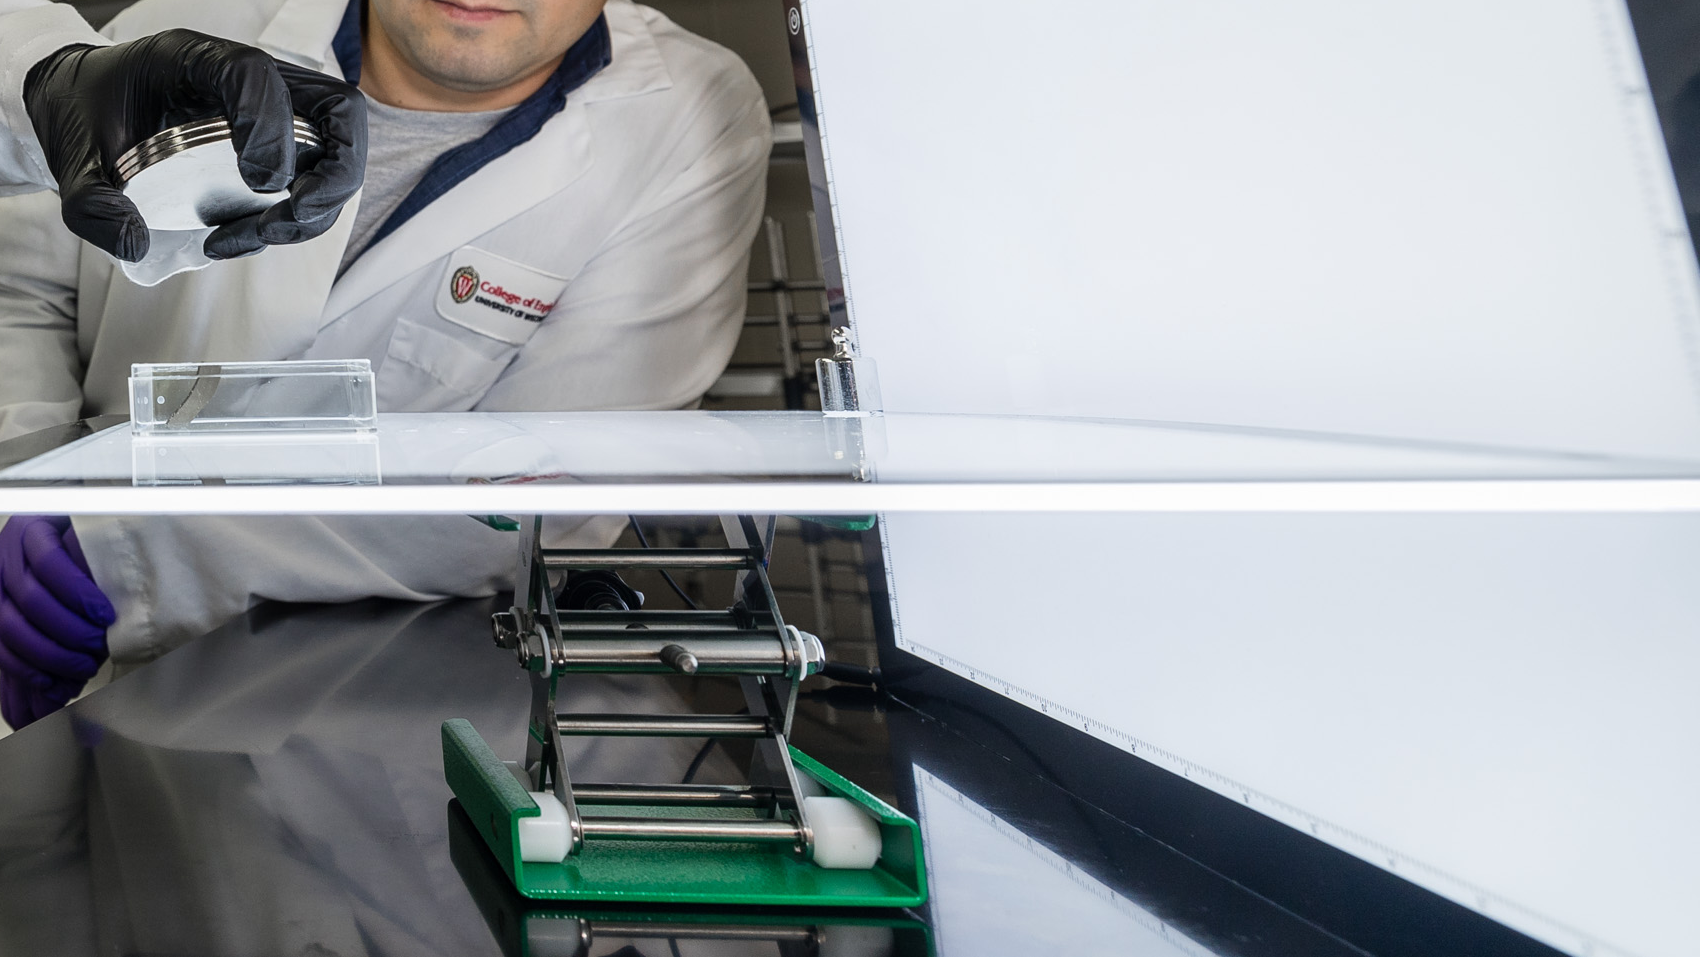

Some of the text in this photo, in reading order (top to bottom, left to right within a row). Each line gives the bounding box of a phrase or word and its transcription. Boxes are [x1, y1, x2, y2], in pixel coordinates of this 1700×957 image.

[474, 295, 514, 316] UNIVERSITY
[480, 281, 521, 305] College
[523, 297, 536, 308] of
